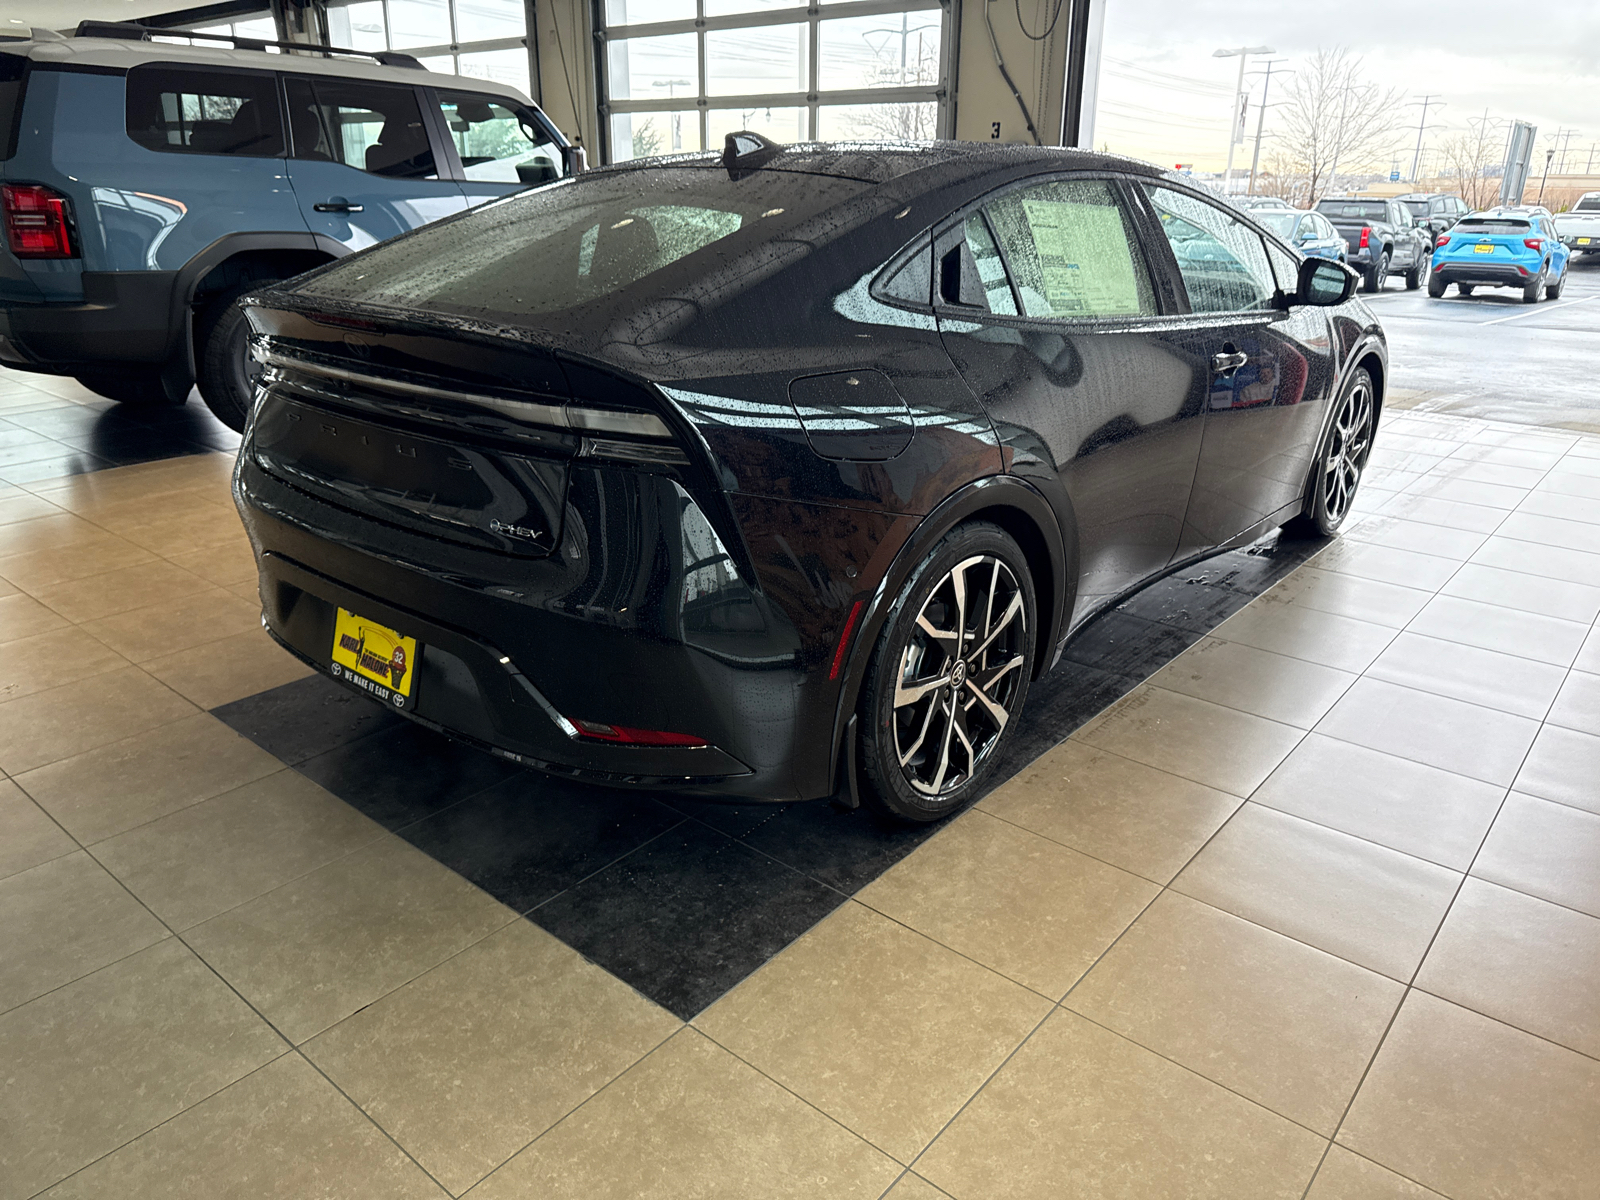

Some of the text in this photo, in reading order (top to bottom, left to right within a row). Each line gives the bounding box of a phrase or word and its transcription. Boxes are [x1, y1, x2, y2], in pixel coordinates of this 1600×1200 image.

[991, 121, 1001, 139] 3
[499, 522, 543, 539] PHEV
[394, 651, 404, 665] 32
[344, 670, 389, 699] WE MAKE IT EASY
